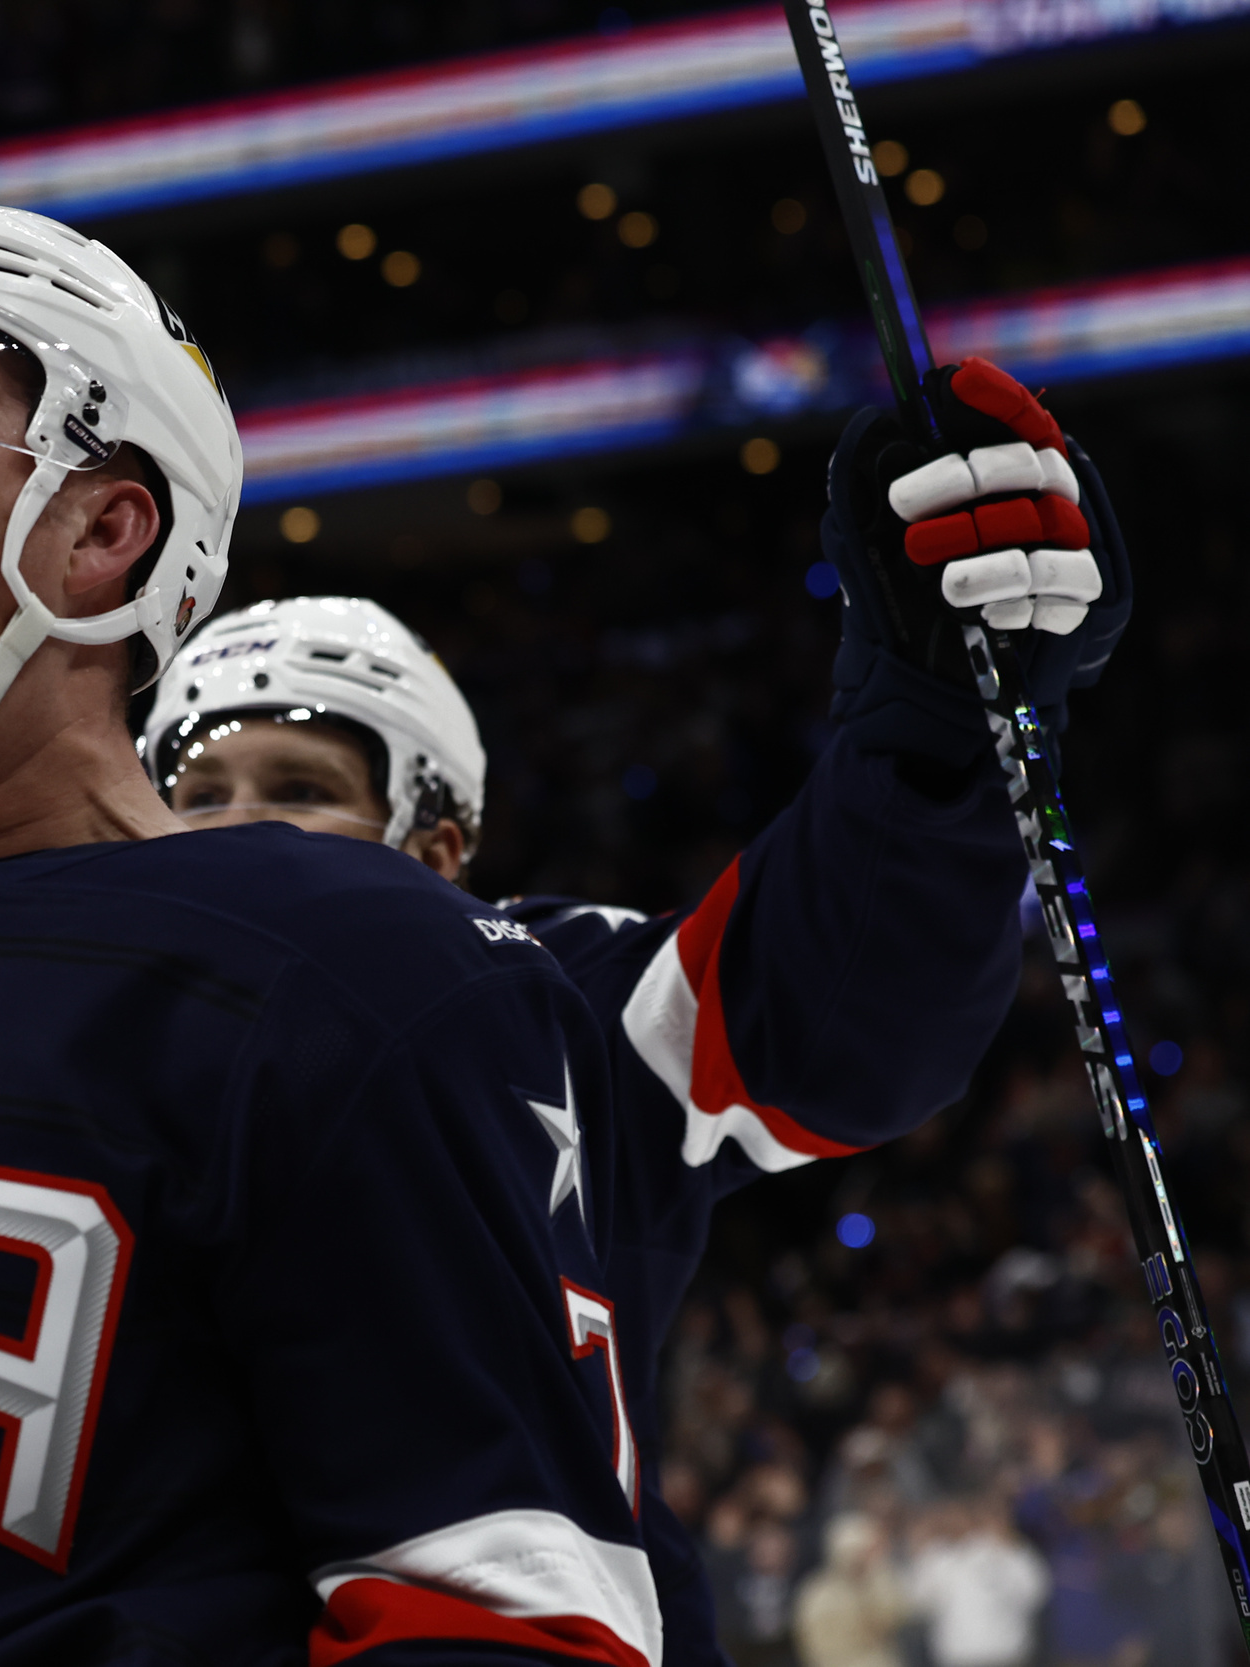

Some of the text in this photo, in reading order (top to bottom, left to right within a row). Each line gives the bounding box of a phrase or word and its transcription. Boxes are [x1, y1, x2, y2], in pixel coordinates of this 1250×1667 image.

[805, 0, 879, 186] SHERWO
[66, 419, 109, 459] BAUER
[558, 1274, 641, 1522] 7
[1141, 1251, 1214, 1465] CODE
